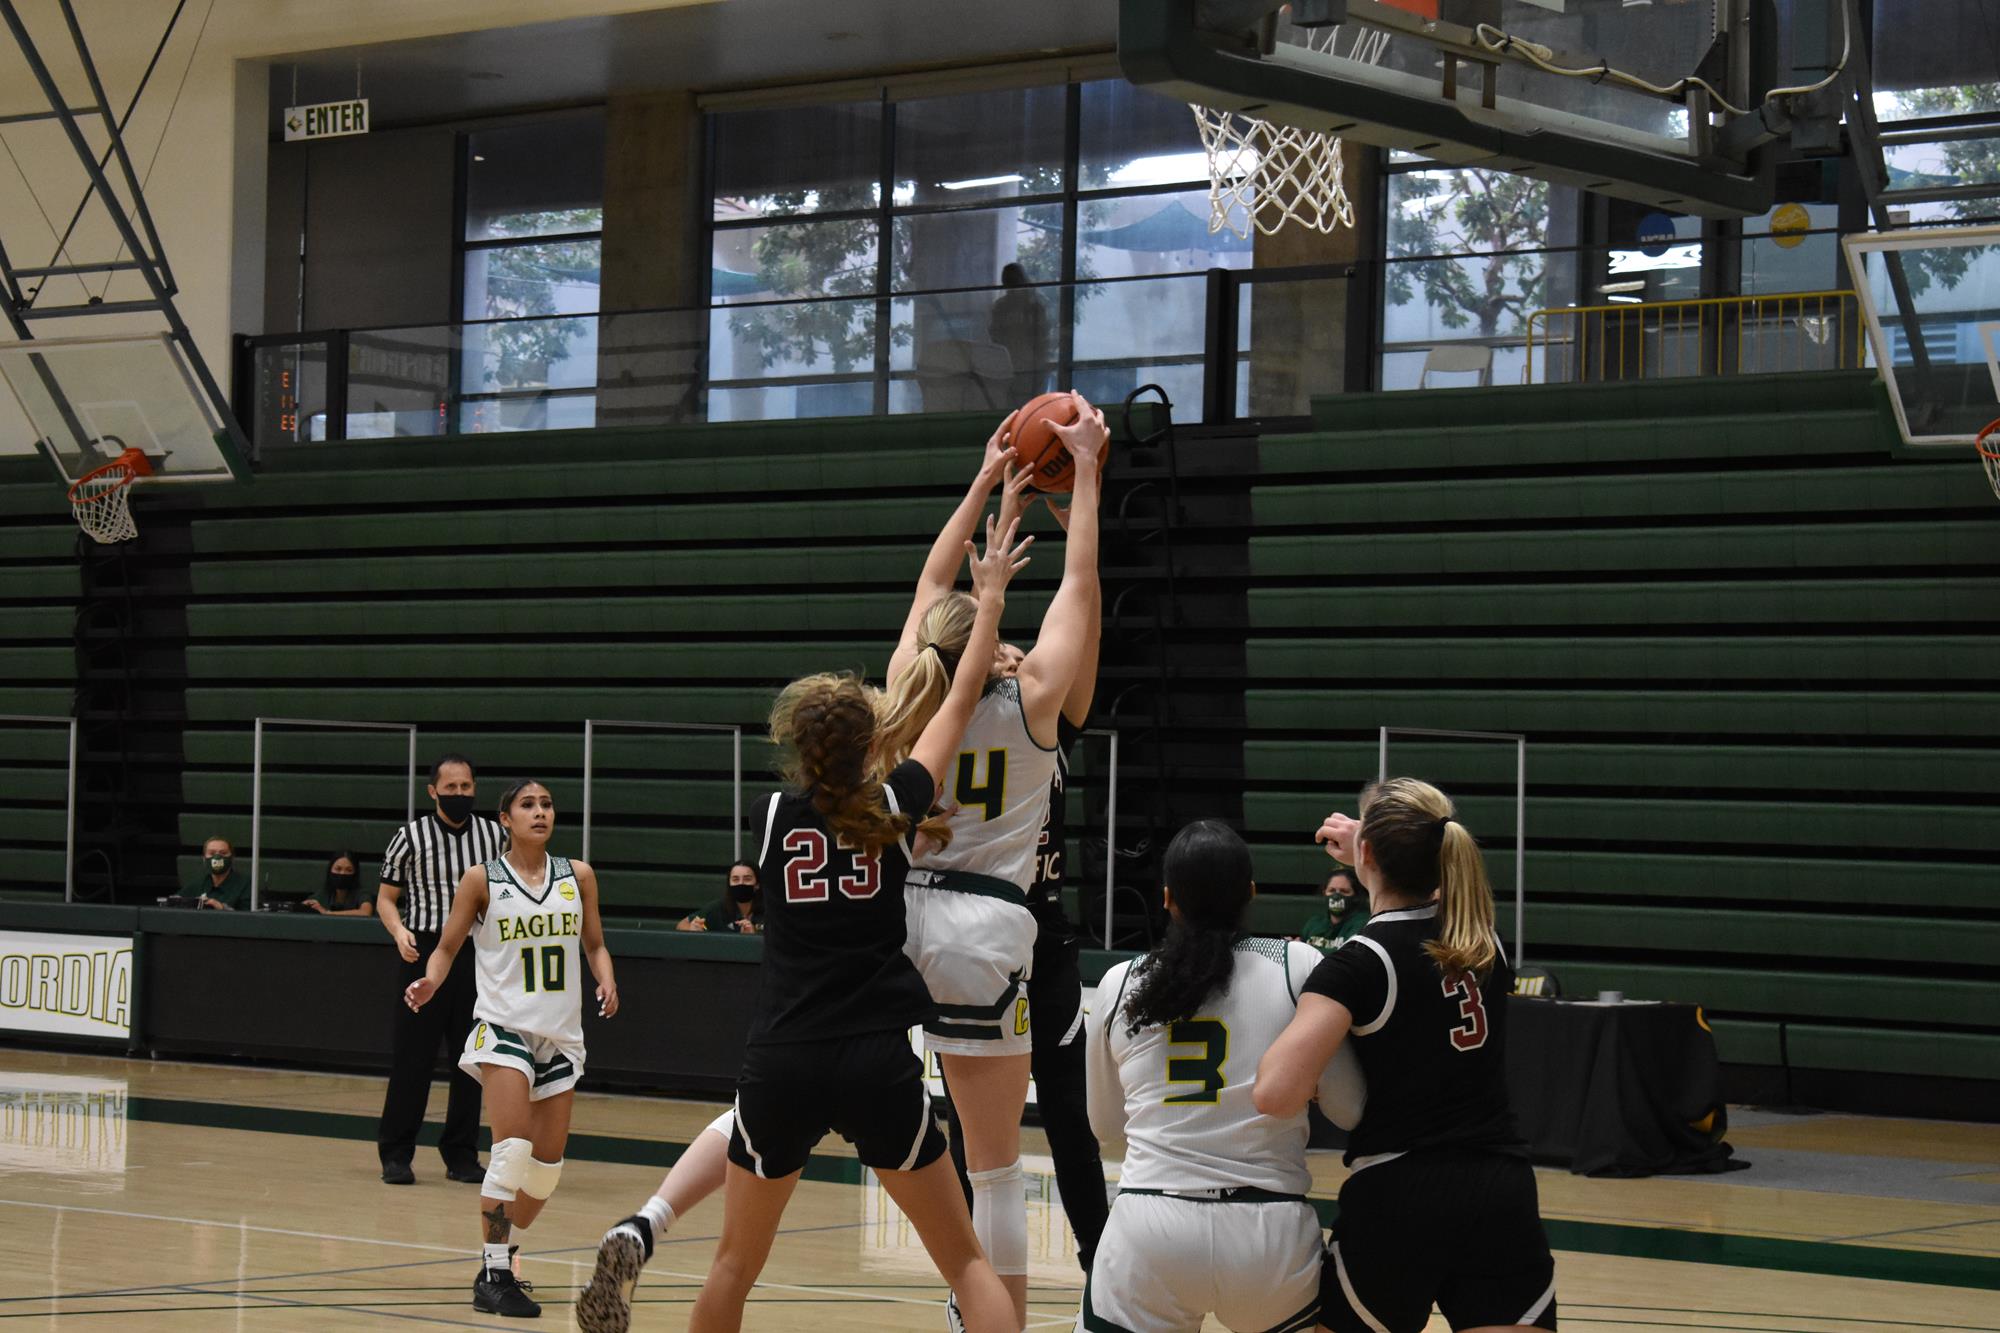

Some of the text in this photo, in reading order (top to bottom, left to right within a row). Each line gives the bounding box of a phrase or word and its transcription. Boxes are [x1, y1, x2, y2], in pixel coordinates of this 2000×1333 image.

[305, 103, 364, 136] ENTER
[783, 828, 882, 903] 23
[0, 949, 133, 1028] ORDIA
[520, 944, 565, 996] 10
[1441, 969, 1489, 1052] 3
[1163, 1016, 1230, 1105] 3
